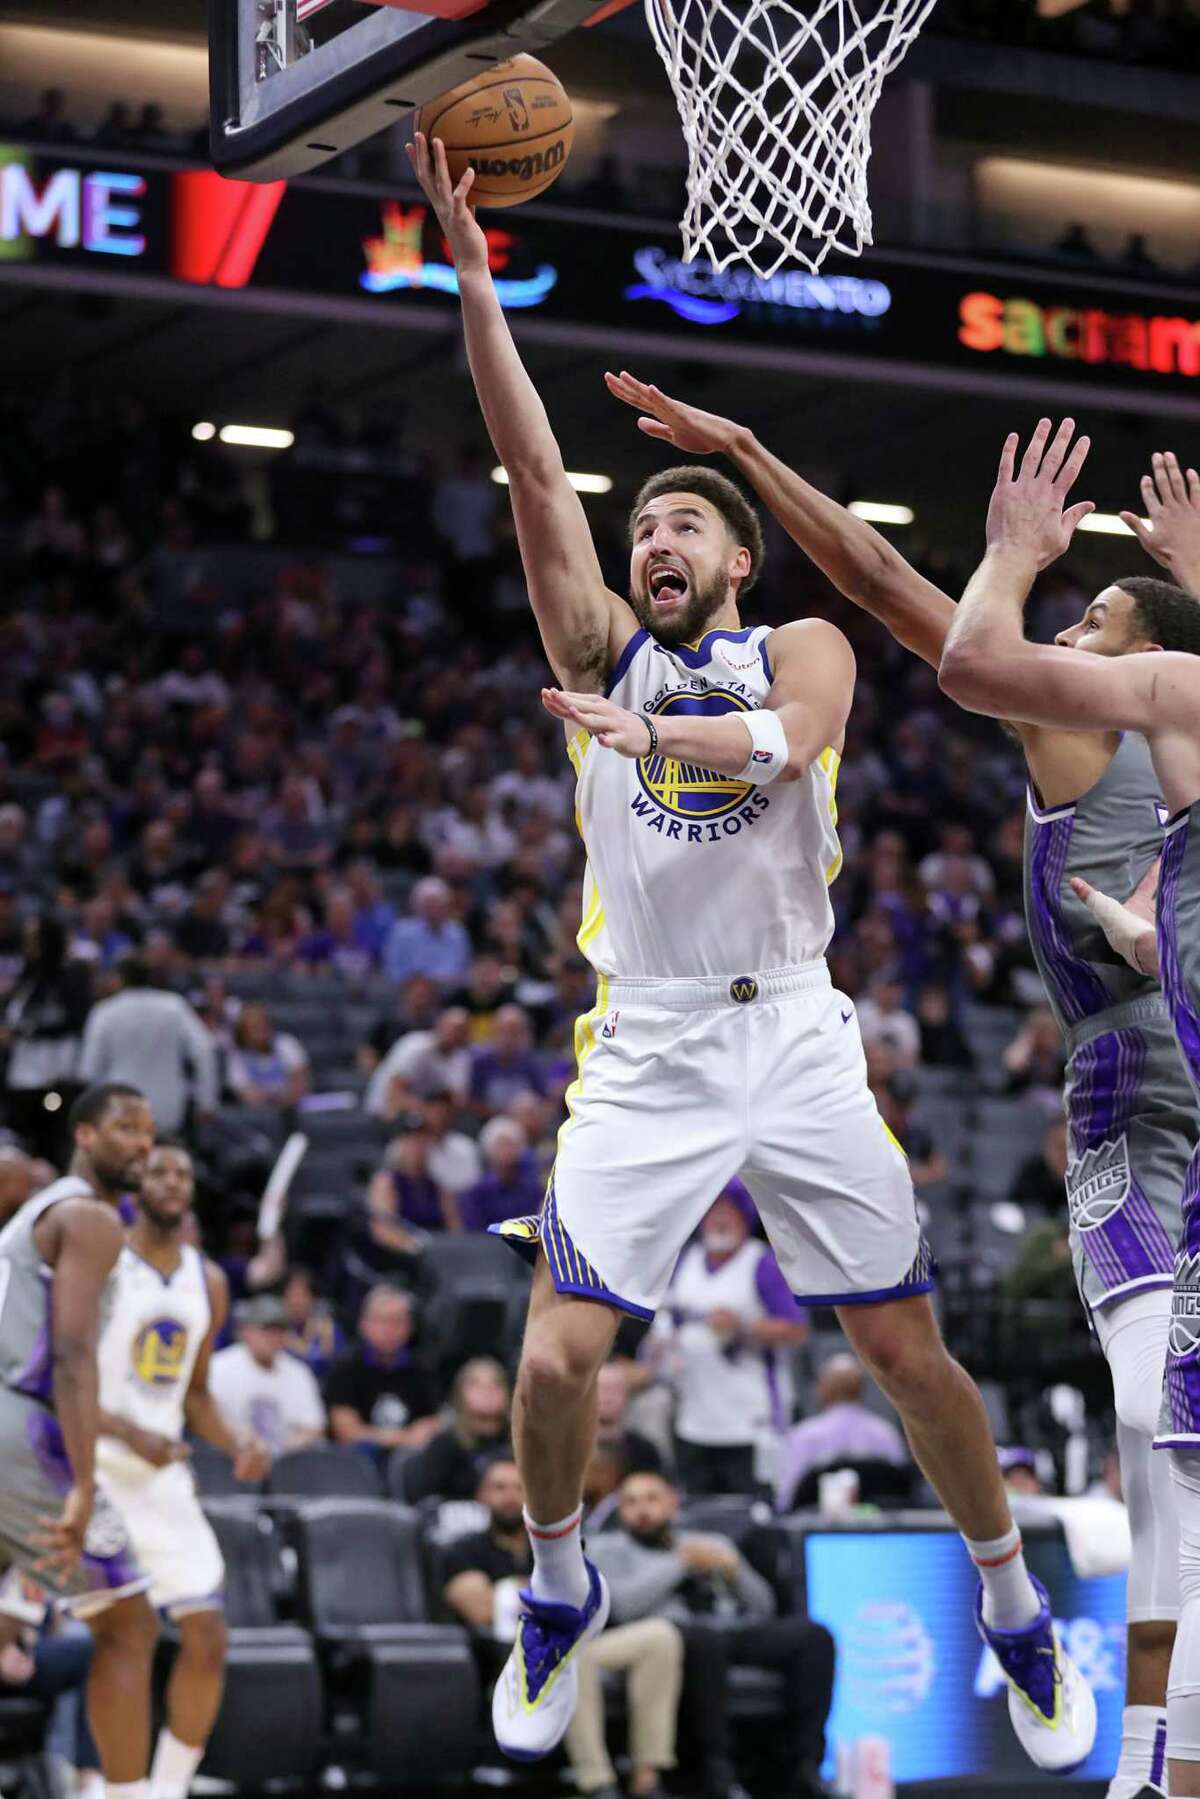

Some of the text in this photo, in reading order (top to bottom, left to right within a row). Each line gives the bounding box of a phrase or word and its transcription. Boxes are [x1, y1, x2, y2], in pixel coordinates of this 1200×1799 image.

[643, 677, 708, 712] GOLDEN
[630, 792, 769, 842] WARRIORS
[732, 982, 756, 1000] W
